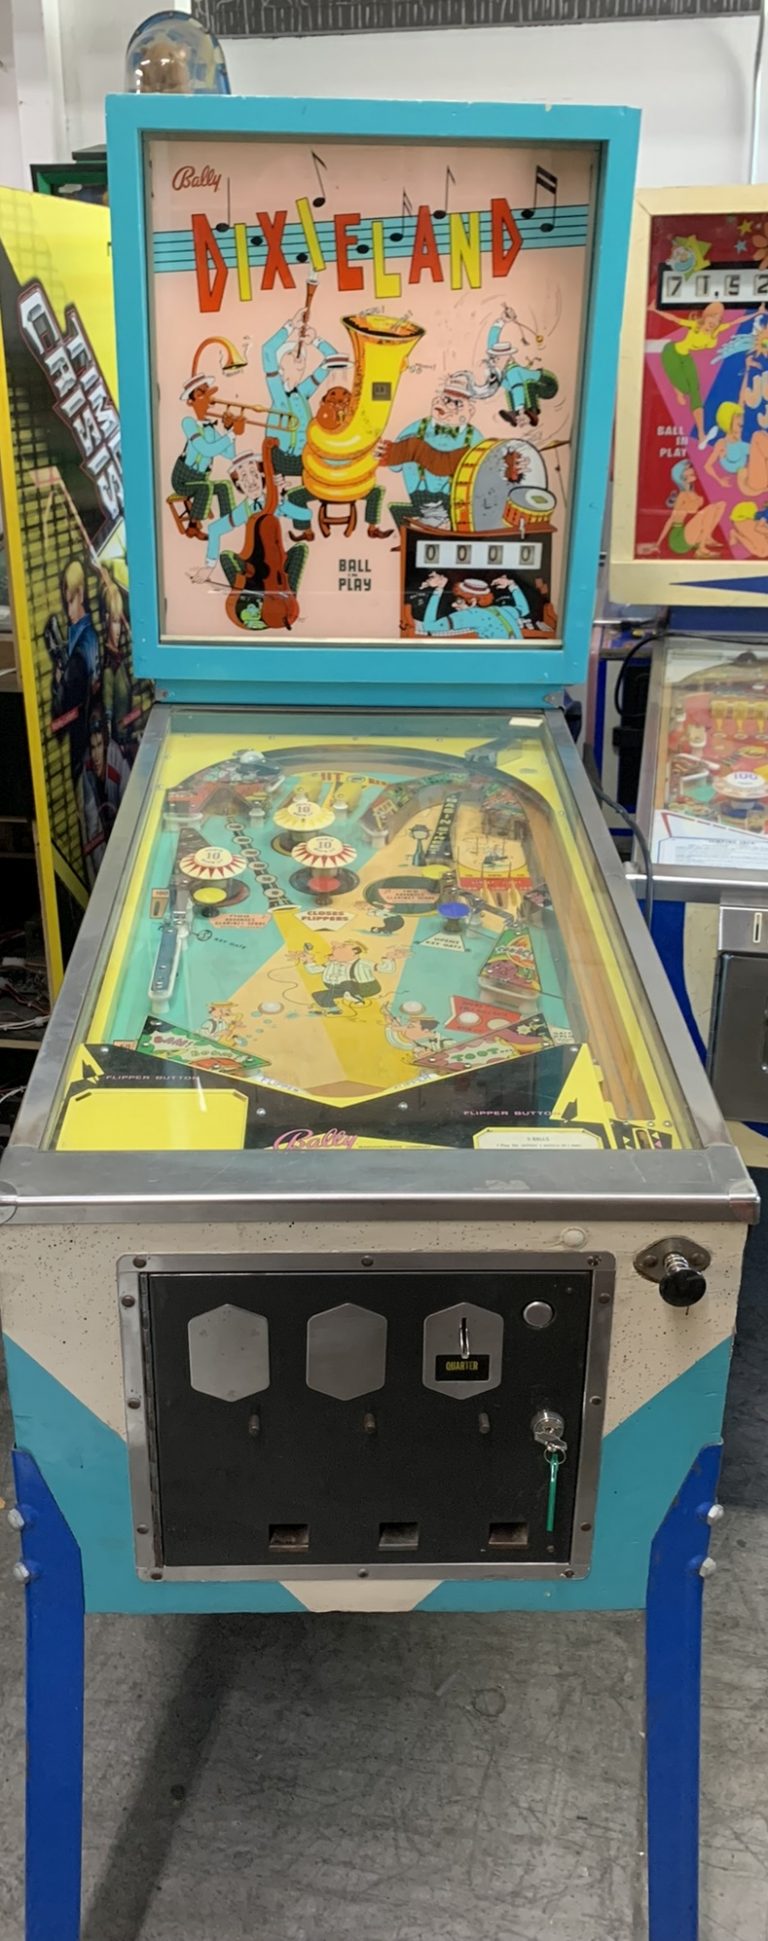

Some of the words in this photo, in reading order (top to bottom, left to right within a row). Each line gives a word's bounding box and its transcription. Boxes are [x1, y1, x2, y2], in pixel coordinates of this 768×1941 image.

[172, 165, 222, 192] Bally
[191, 196, 524, 313] DIXIELAND
[19, 288, 123, 520] CRISIS
[657, 426, 684, 436] BALL
[660, 448, 687, 458] PLAY
[338, 559, 372, 573] BALL
[338, 578, 372, 592] PLAY
[273, 1128, 358, 1151] Bally
[445, 1361, 479, 1371] QUARTER
